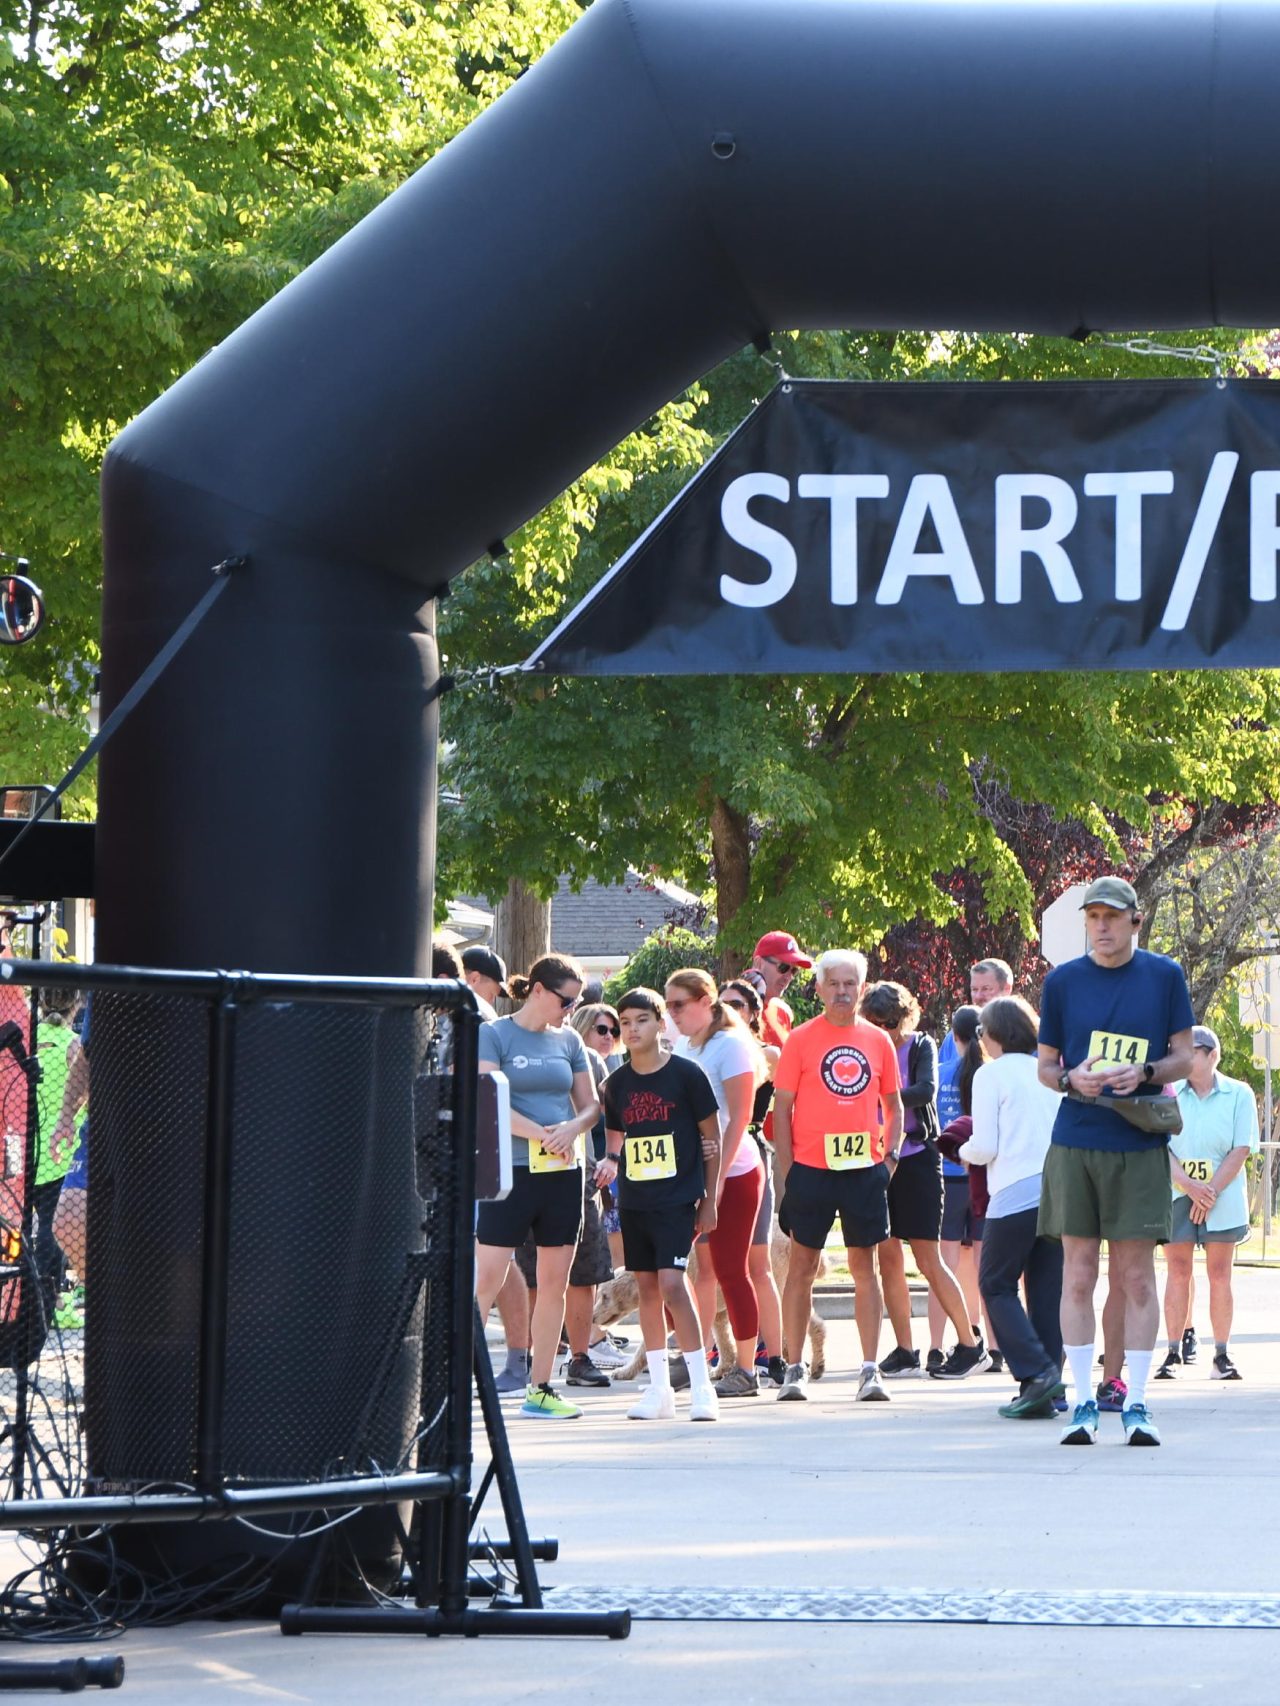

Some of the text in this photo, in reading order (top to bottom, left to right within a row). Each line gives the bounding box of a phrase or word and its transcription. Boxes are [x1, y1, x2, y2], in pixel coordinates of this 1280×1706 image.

[825, 1048, 867, 1066] PROVIDENCE
[1101, 1036, 1138, 1064] 114
[823, 1071, 869, 1096] HEART TO START
[632, 1139, 667, 1165] 134
[832, 1134, 865, 1158] 142
